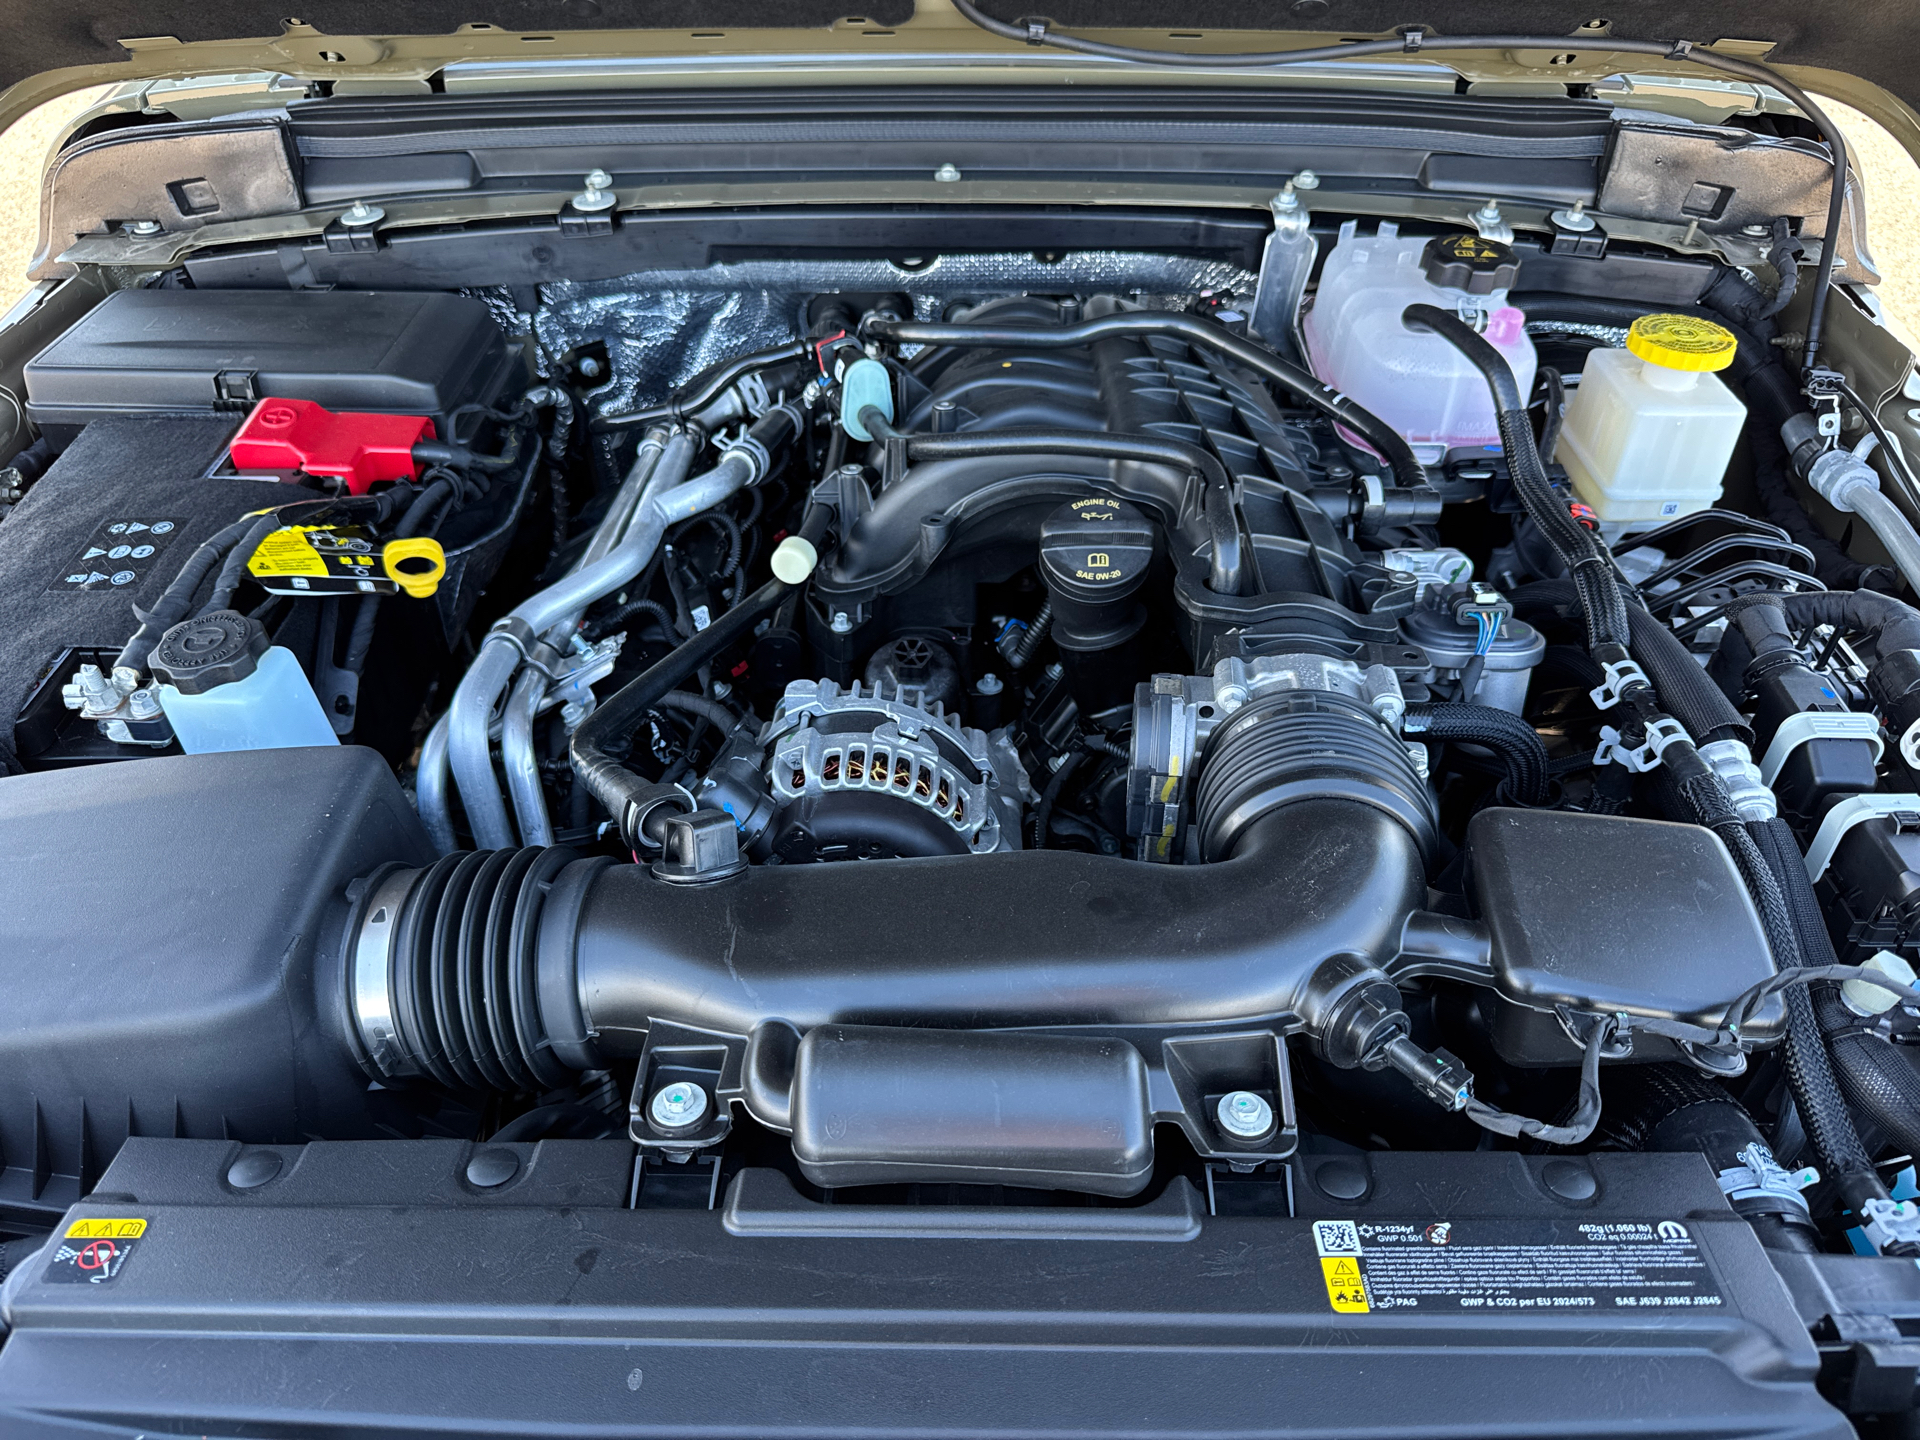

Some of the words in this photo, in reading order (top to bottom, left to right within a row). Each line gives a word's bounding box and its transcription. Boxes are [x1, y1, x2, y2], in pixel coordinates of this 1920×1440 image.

[1071, 498, 1105, 510] ENGINE
[1106, 499, 1120, 510] OIL
[1075, 569, 1094, 580] SAE
[1095, 569, 1121, 580] 0W-20
[1375, 1225, 1414, 1234] R-1234yf
[1578, 1224, 1604, 1234] 482g
[1400, 1234, 1423, 1242] 0.501
[1587, 1233, 1607, 1241] CO2
[1397, 1298, 1418, 1306] PAG
[1460, 1298, 1484, 1306] GWP
[1486, 1298, 1494, 1306] &
[1496, 1298, 1517, 1306] CO2
[1519, 1299, 1535, 1308] per
[1536, 1297, 1551, 1306] EU
[1553, 1297, 1595, 1306] 2024/573
[1615, 1297, 1637, 1306] SAE
[1639, 1297, 1661, 1306] J639
[1663, 1297, 1691, 1306] J2842
[1693, 1296, 1722, 1306] J2845
